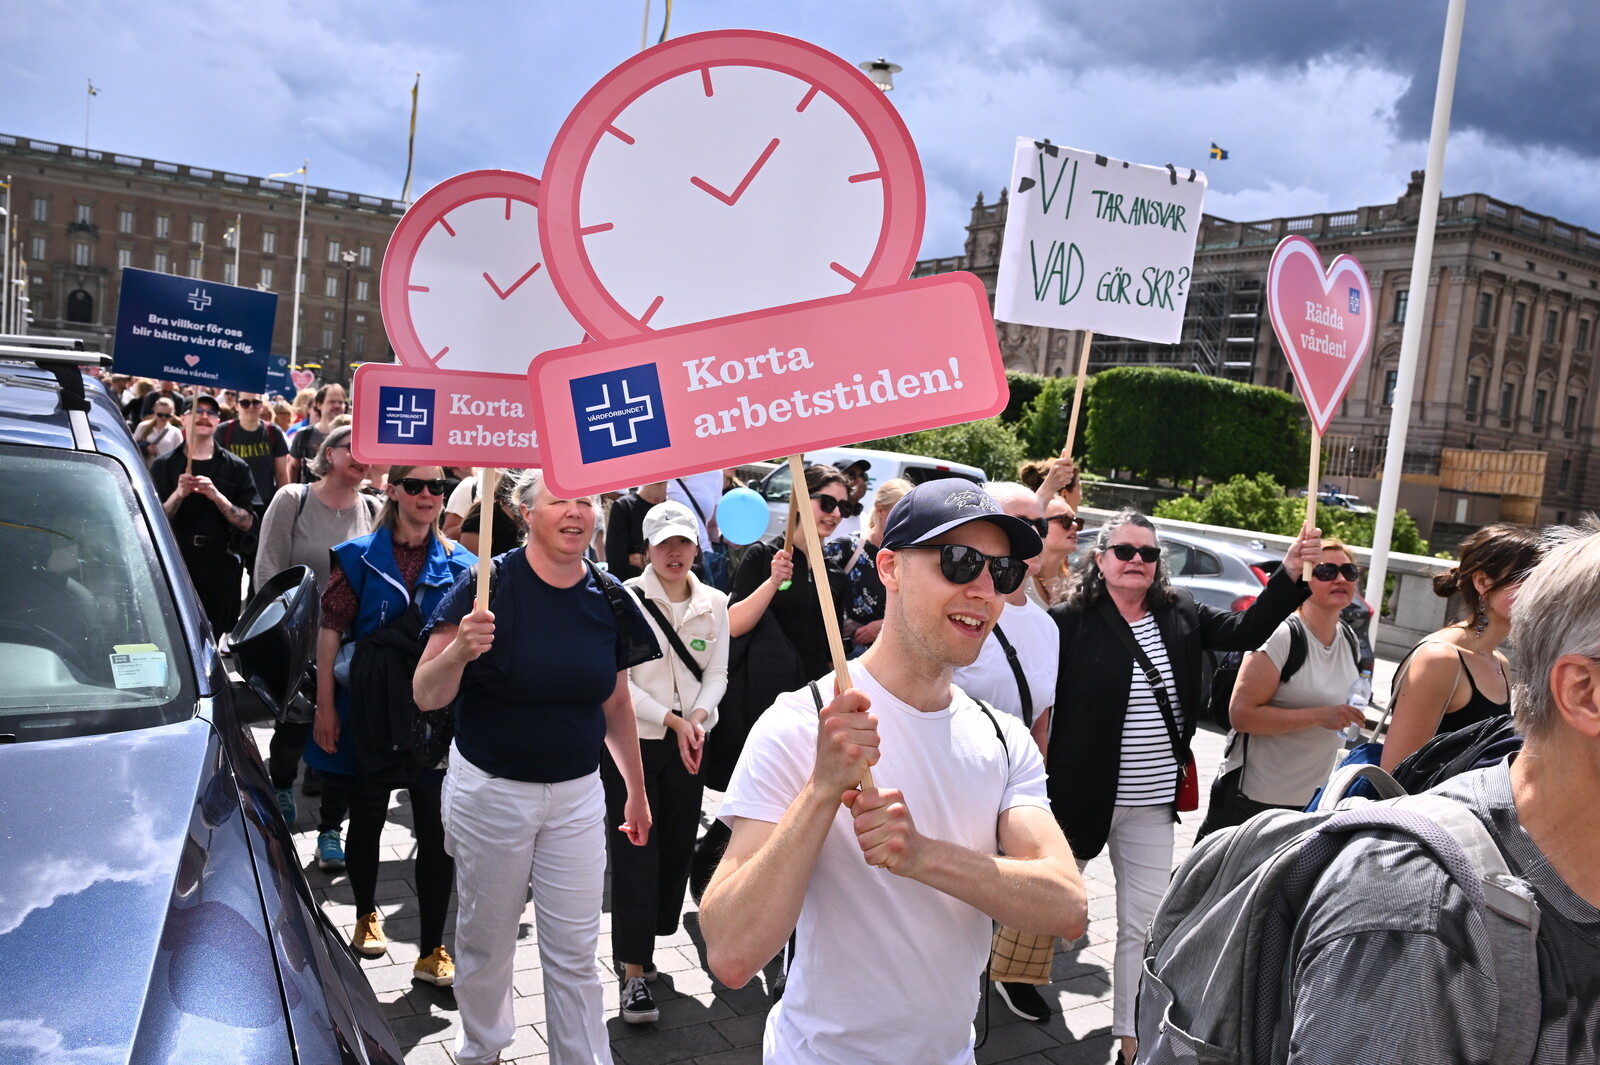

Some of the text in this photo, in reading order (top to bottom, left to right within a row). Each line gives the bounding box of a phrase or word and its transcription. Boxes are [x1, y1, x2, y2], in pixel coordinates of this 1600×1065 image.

[1039, 152, 1187, 233] VI TAR ANSVAR
[1030, 239, 1190, 311] VAD GÖR SKR?
[148, 313, 243, 338] Bra villkor för oss
[1305, 300, 1344, 331] Rädda
[132, 325, 255, 355] blir bättre vård för dig.
[1300, 328, 1347, 359] vården!
[163, 365, 219, 380] Rädda vården!
[683, 346, 815, 392] Korta
[449, 393, 525, 418] Korta
[693, 356, 965, 438] arbetstiden!
[586, 405, 645, 422] VÅRDFÖRBUNDET
[448, 424, 539, 448] arbetst
